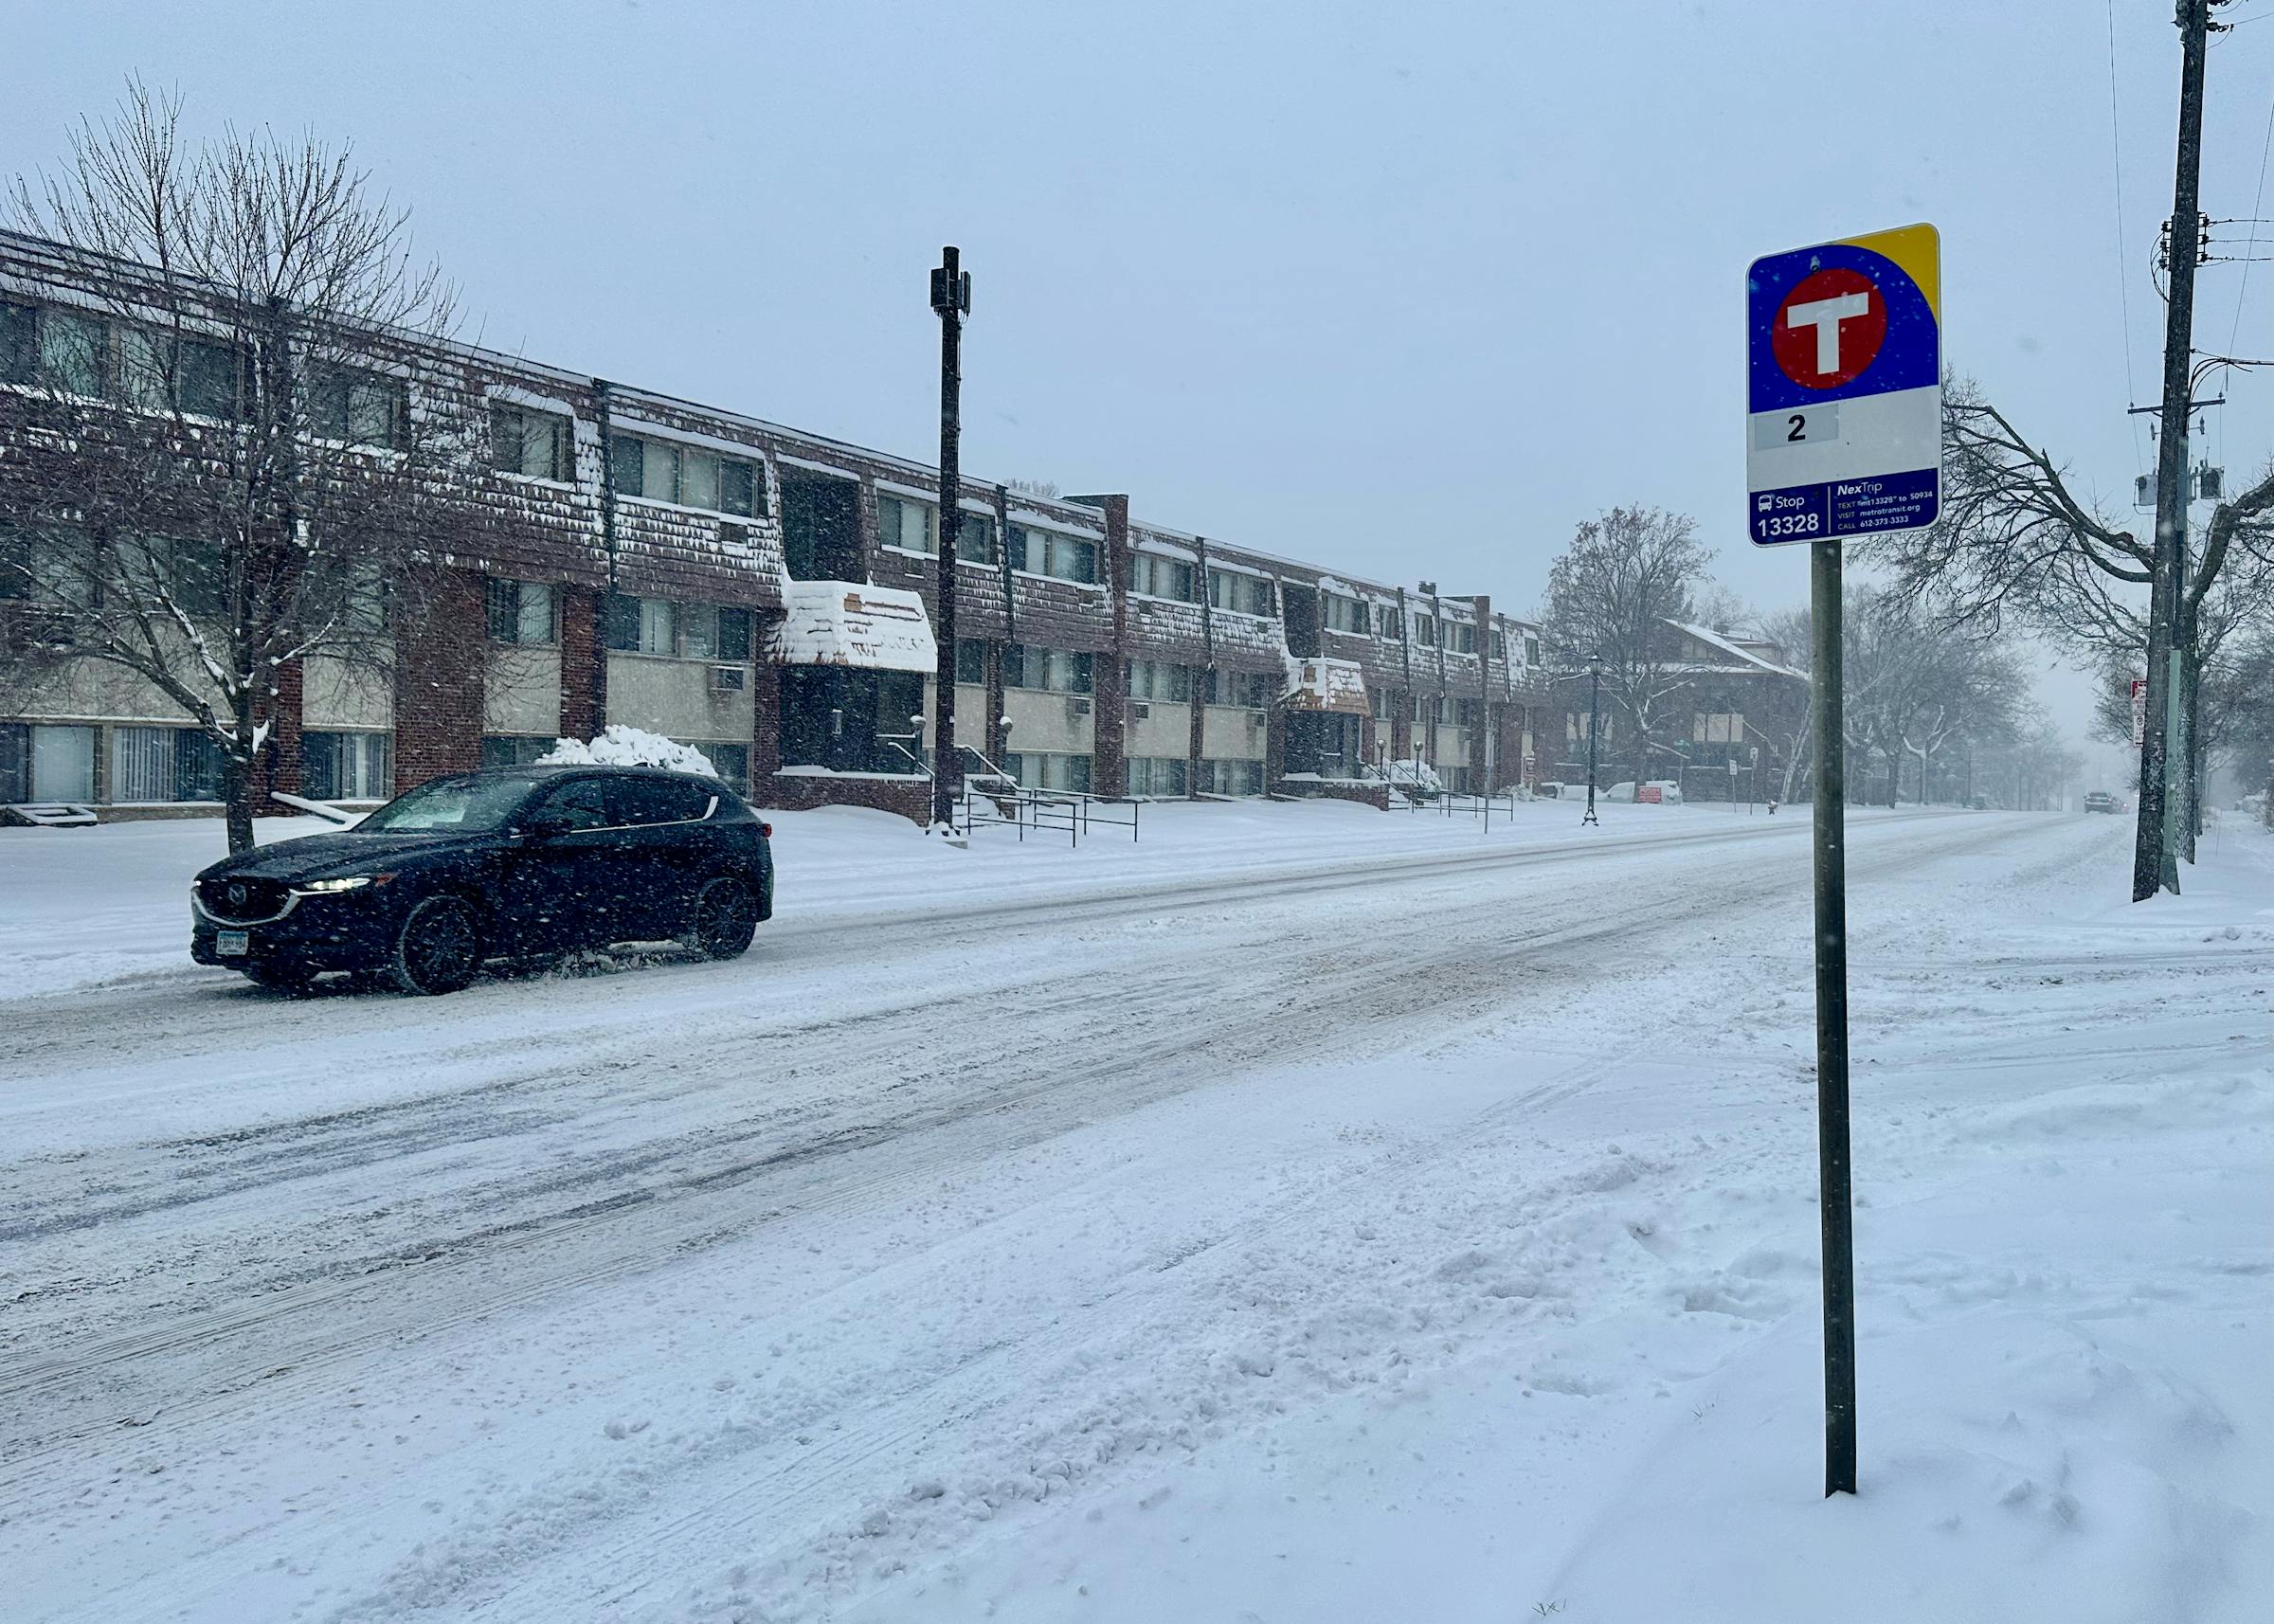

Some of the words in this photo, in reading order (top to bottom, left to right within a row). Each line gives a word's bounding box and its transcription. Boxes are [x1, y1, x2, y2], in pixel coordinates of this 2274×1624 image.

[1787, 292, 1868, 375] T
[1787, 414, 1806, 442] 2
[1837, 481, 1883, 496] NexTrip
[1776, 496, 1805, 511] Stop
[1837, 500, 1856, 509] TEXT
[1837, 511, 1855, 519] VISIT
[1860, 504, 1921, 517] metrotransit.org
[1758, 513, 1819, 537] 13328
[1860, 515, 1909, 528] 612-373-3333
